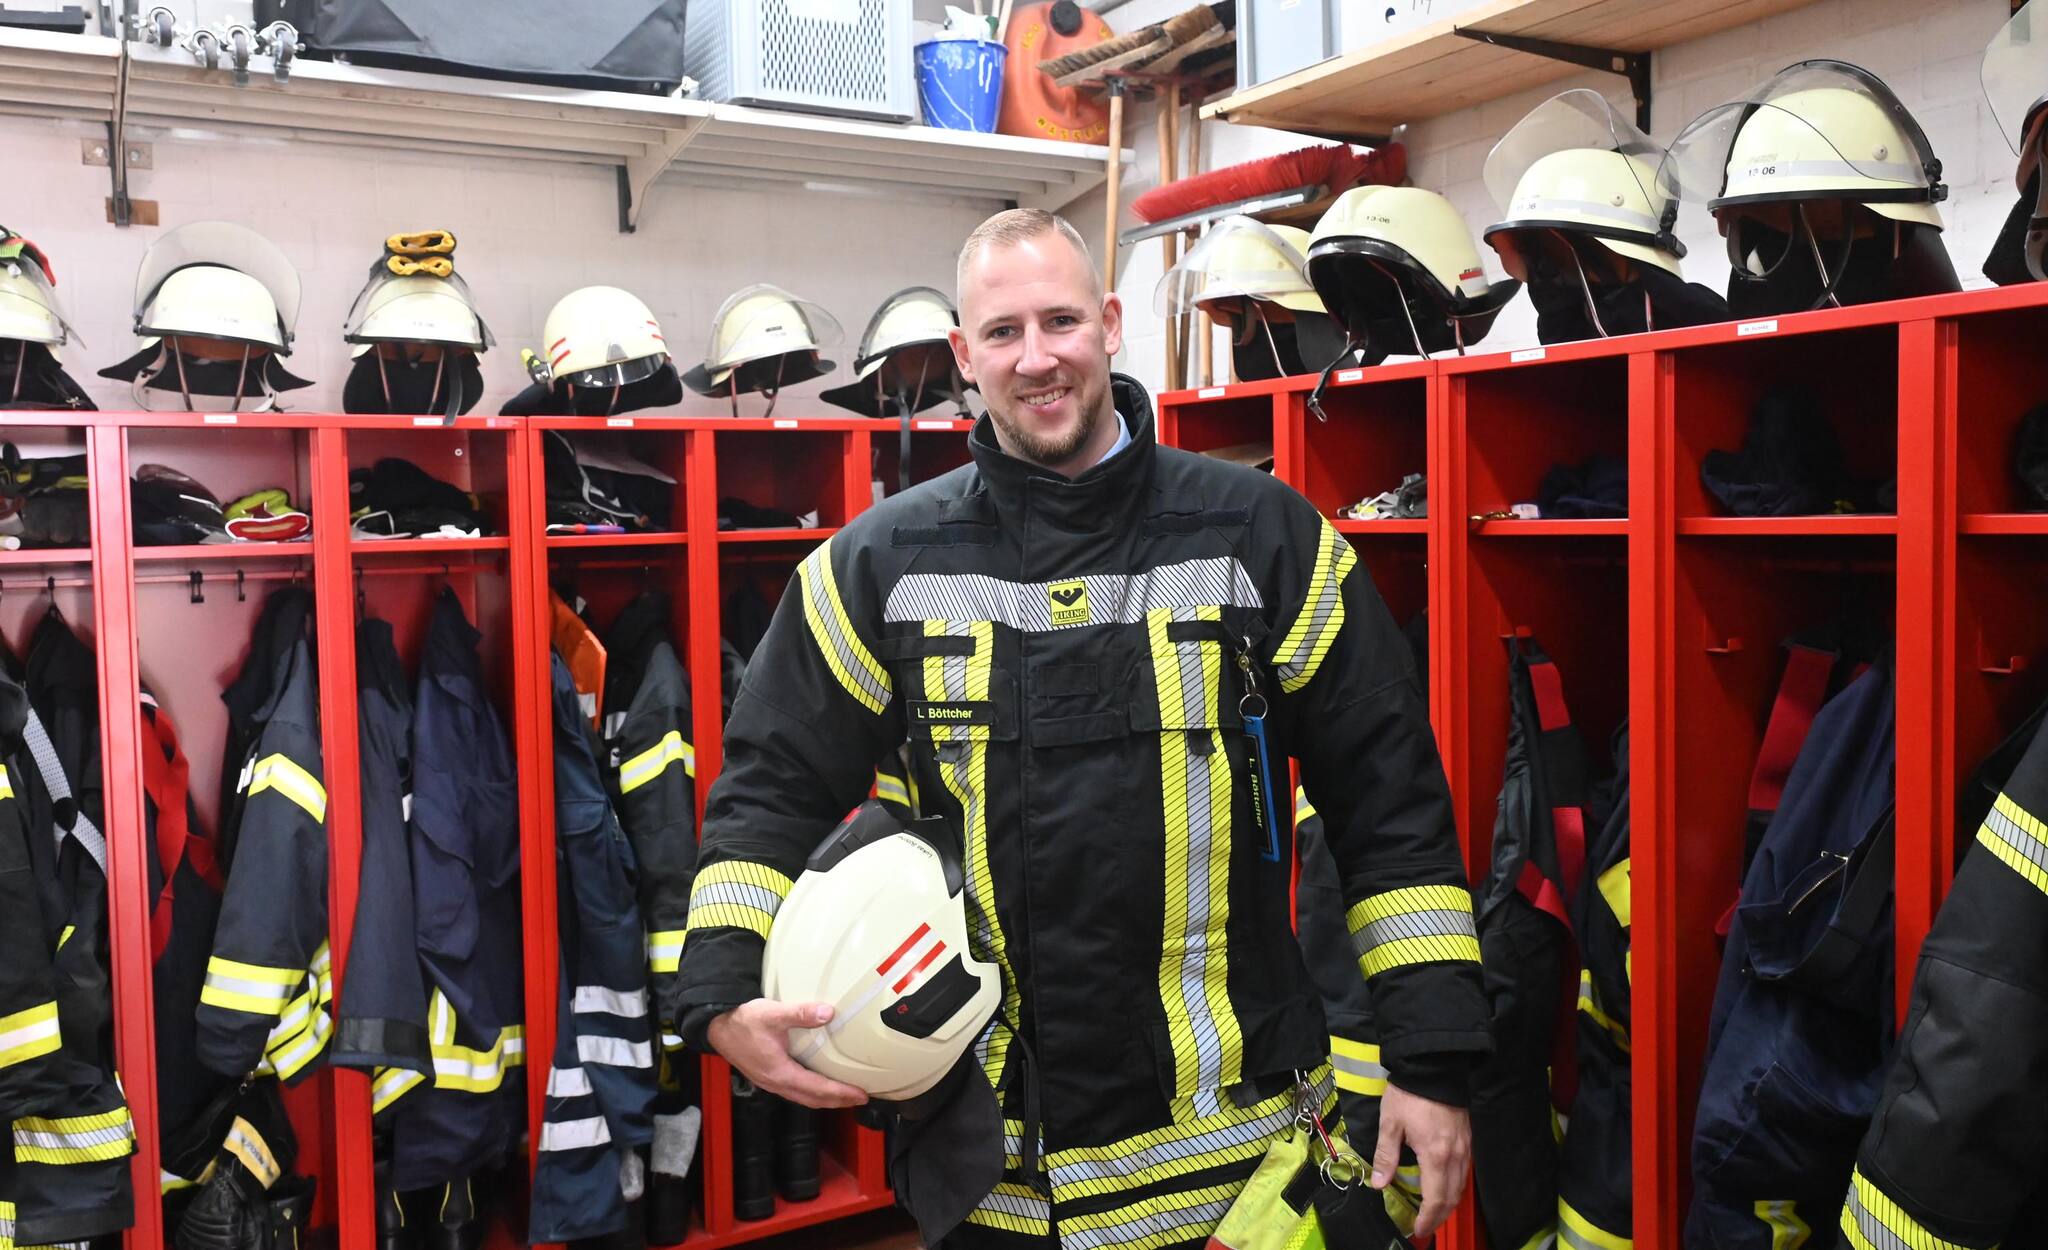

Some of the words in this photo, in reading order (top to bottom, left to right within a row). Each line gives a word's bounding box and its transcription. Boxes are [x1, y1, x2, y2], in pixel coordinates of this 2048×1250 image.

[1053, 608, 1087, 620] VIKING
[928, 707, 973, 719] Böttcher
[1250, 773, 1263, 829] Böttcher
